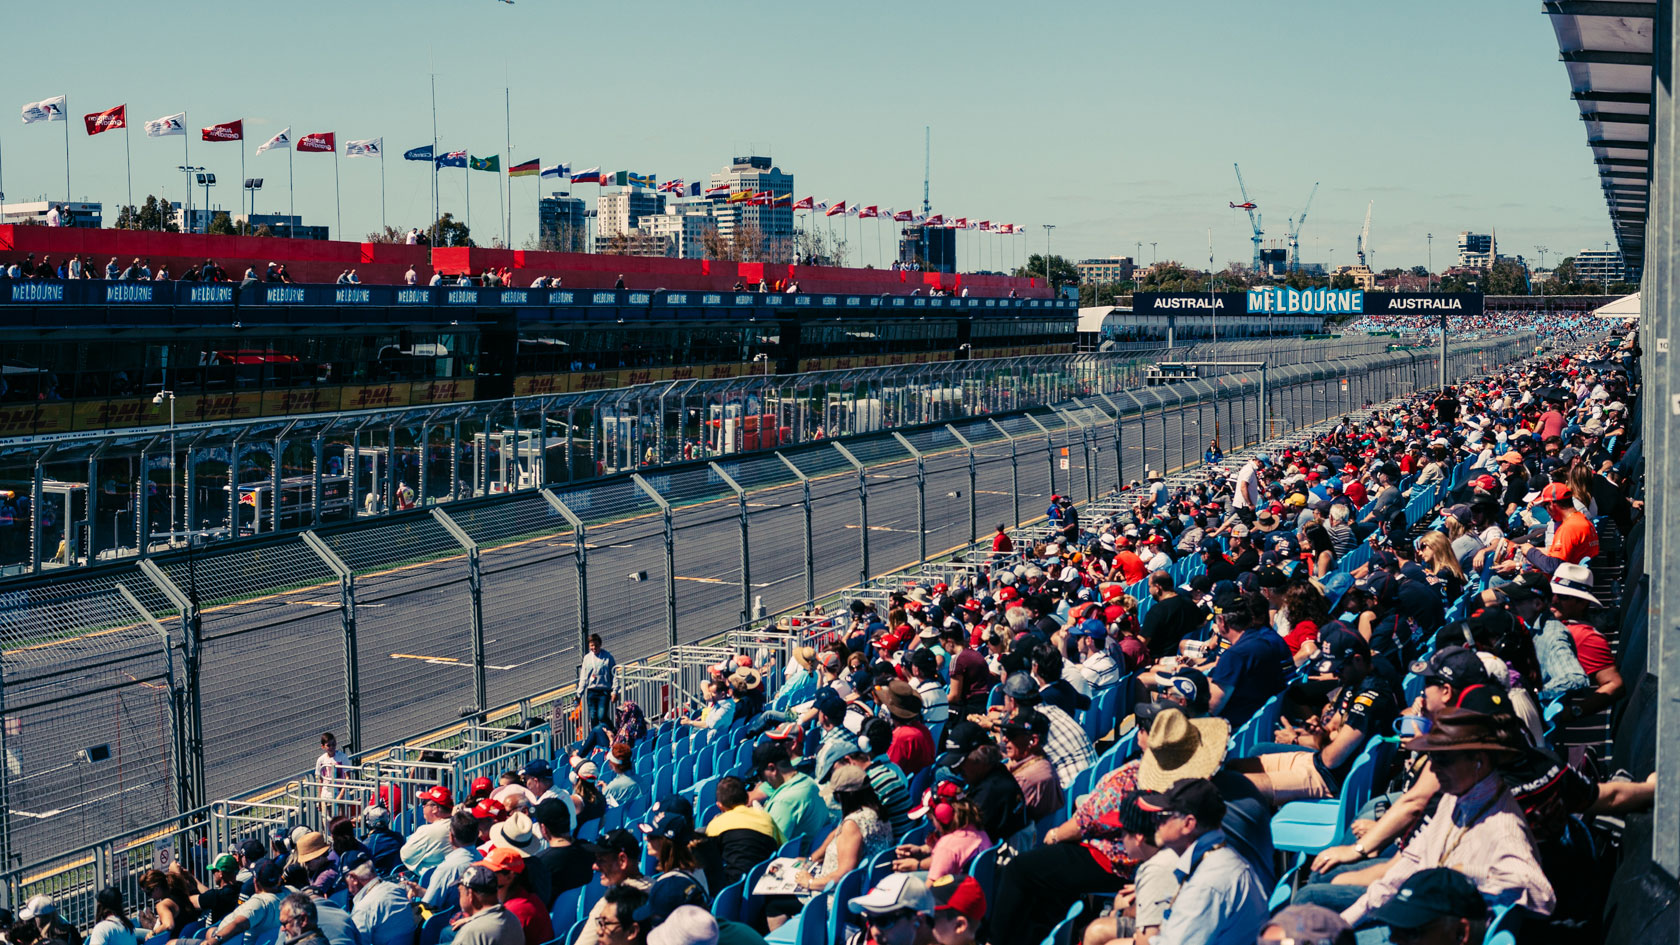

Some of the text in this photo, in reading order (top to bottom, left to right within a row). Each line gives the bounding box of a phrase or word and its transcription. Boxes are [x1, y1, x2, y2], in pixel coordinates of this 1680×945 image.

[12, 284, 63, 300] MELBOURNE
[107, 285, 152, 301] MELBOURNE
[191, 286, 232, 301] MELBOURNE
[267, 288, 304, 302] MELBOURNE
[336, 288, 370, 302] MELBOURNE
[398, 290, 429, 303] MELBOURNE
[448, 290, 478, 304] MELBOURNE
[1153, 297, 1225, 309] AUSTRALIA
[1249, 289, 1362, 312] MELBOURNE
[1388, 298, 1462, 309] AUSTRALIA
[357, 387, 394, 405] DHL
[426, 383, 459, 400] DHL
